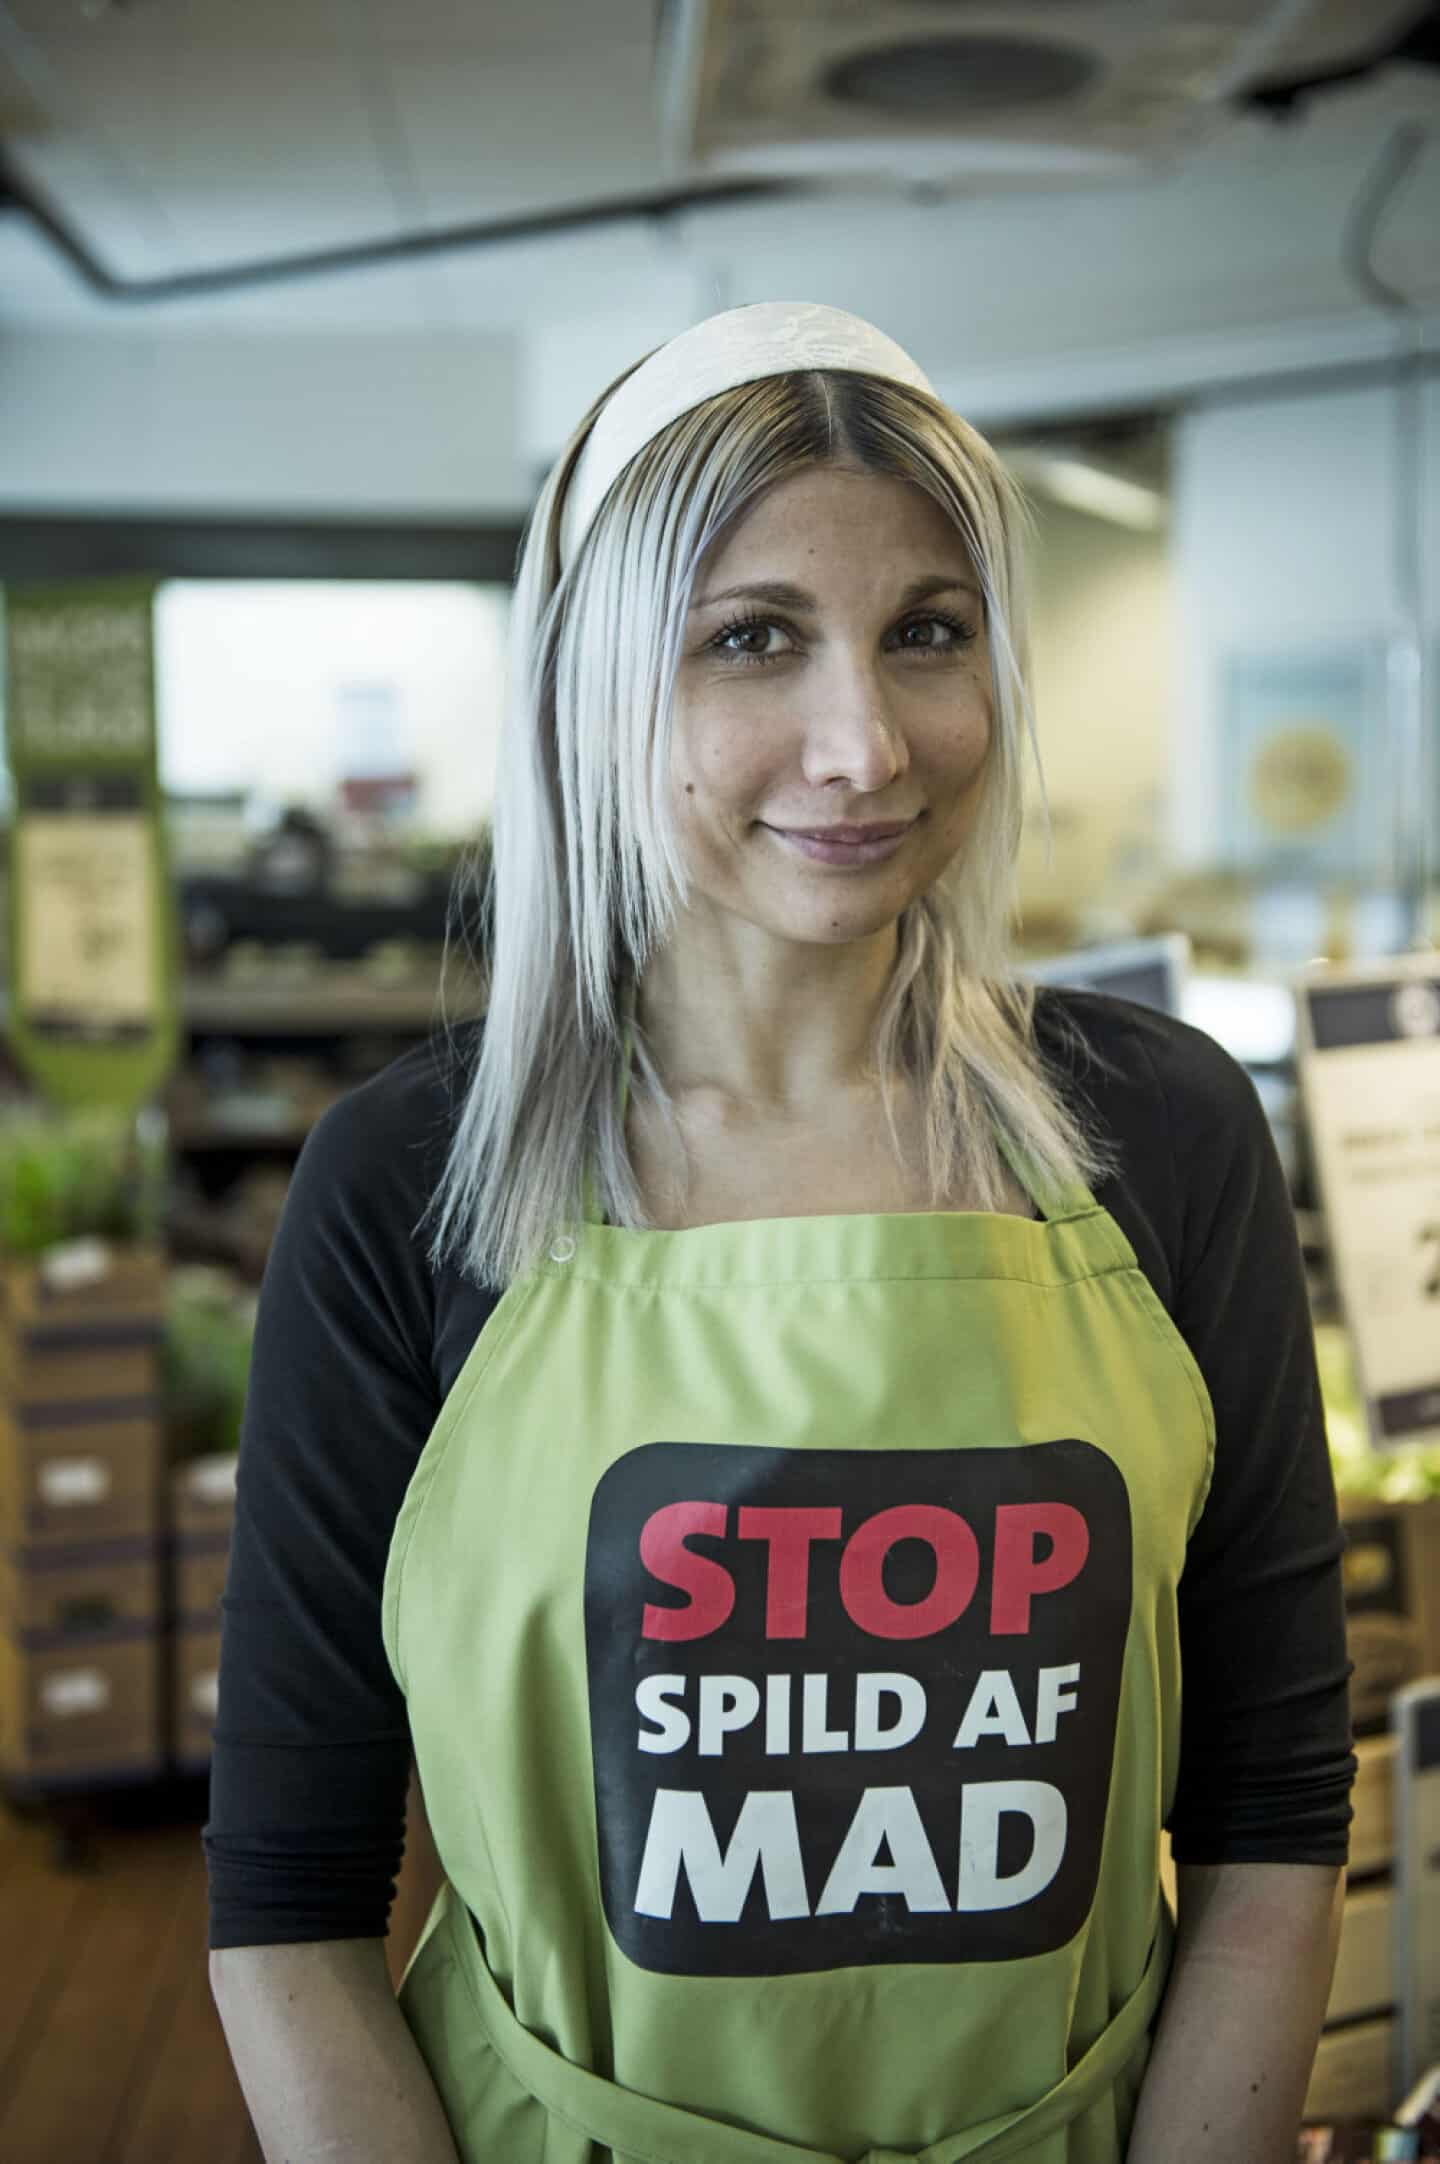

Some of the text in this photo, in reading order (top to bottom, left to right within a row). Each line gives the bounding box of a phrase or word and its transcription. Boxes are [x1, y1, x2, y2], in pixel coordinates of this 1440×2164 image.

[639, 1500, 1090, 1641] STOP
[635, 1662, 1081, 1756] SPILD AF
[633, 1779, 1069, 1923] MAD
